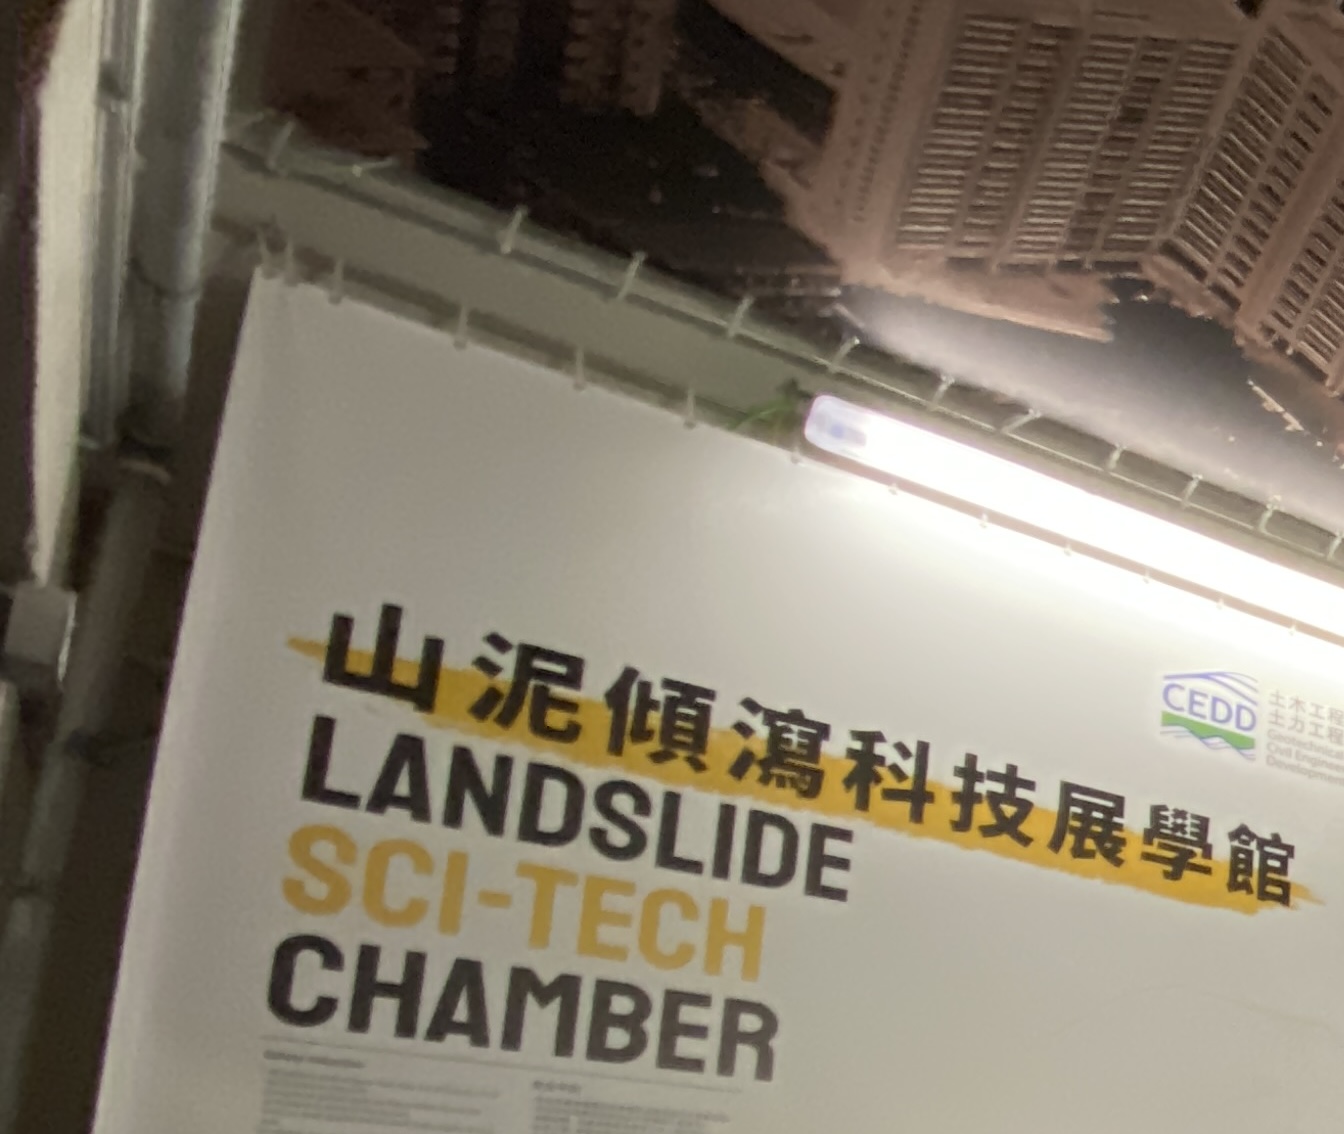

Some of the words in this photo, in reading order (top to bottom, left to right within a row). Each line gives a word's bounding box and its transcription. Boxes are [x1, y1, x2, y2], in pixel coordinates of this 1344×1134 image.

[323, 602, 1296, 908] 山泥傾瀉科技展學館
[1162, 682, 1257, 732] CEDD
[301, 714, 854, 902] LANDSLIDE
[281, 824, 767, 982] SCI-TECH
[266, 933, 780, 1082] CHAMBER
